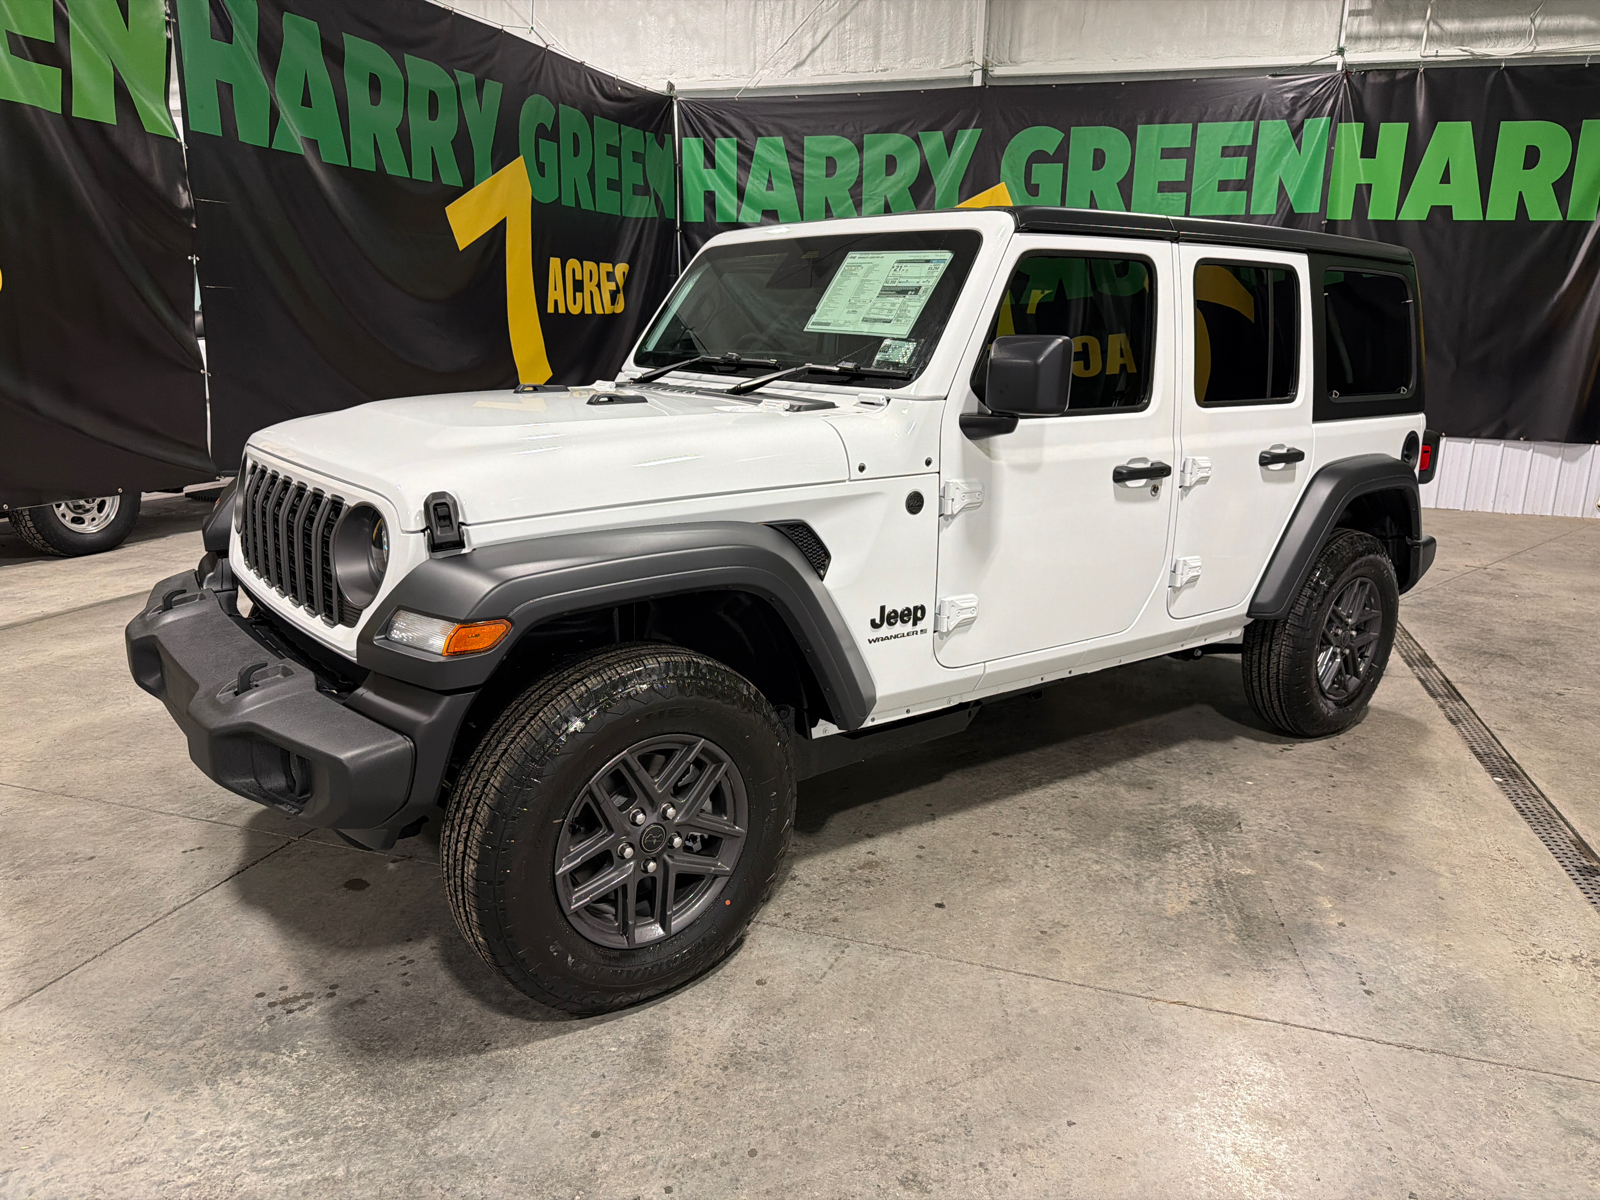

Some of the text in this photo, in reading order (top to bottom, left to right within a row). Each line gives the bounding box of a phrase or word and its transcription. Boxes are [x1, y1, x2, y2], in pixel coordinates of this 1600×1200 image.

[177, 0, 675, 219] HARRY GREEN
[682, 117, 1331, 222] HARRY GREEN
[547, 257, 630, 315] ACRES
[867, 630, 918, 644] WRANGLER
[870, 604, 926, 629] Jeep
